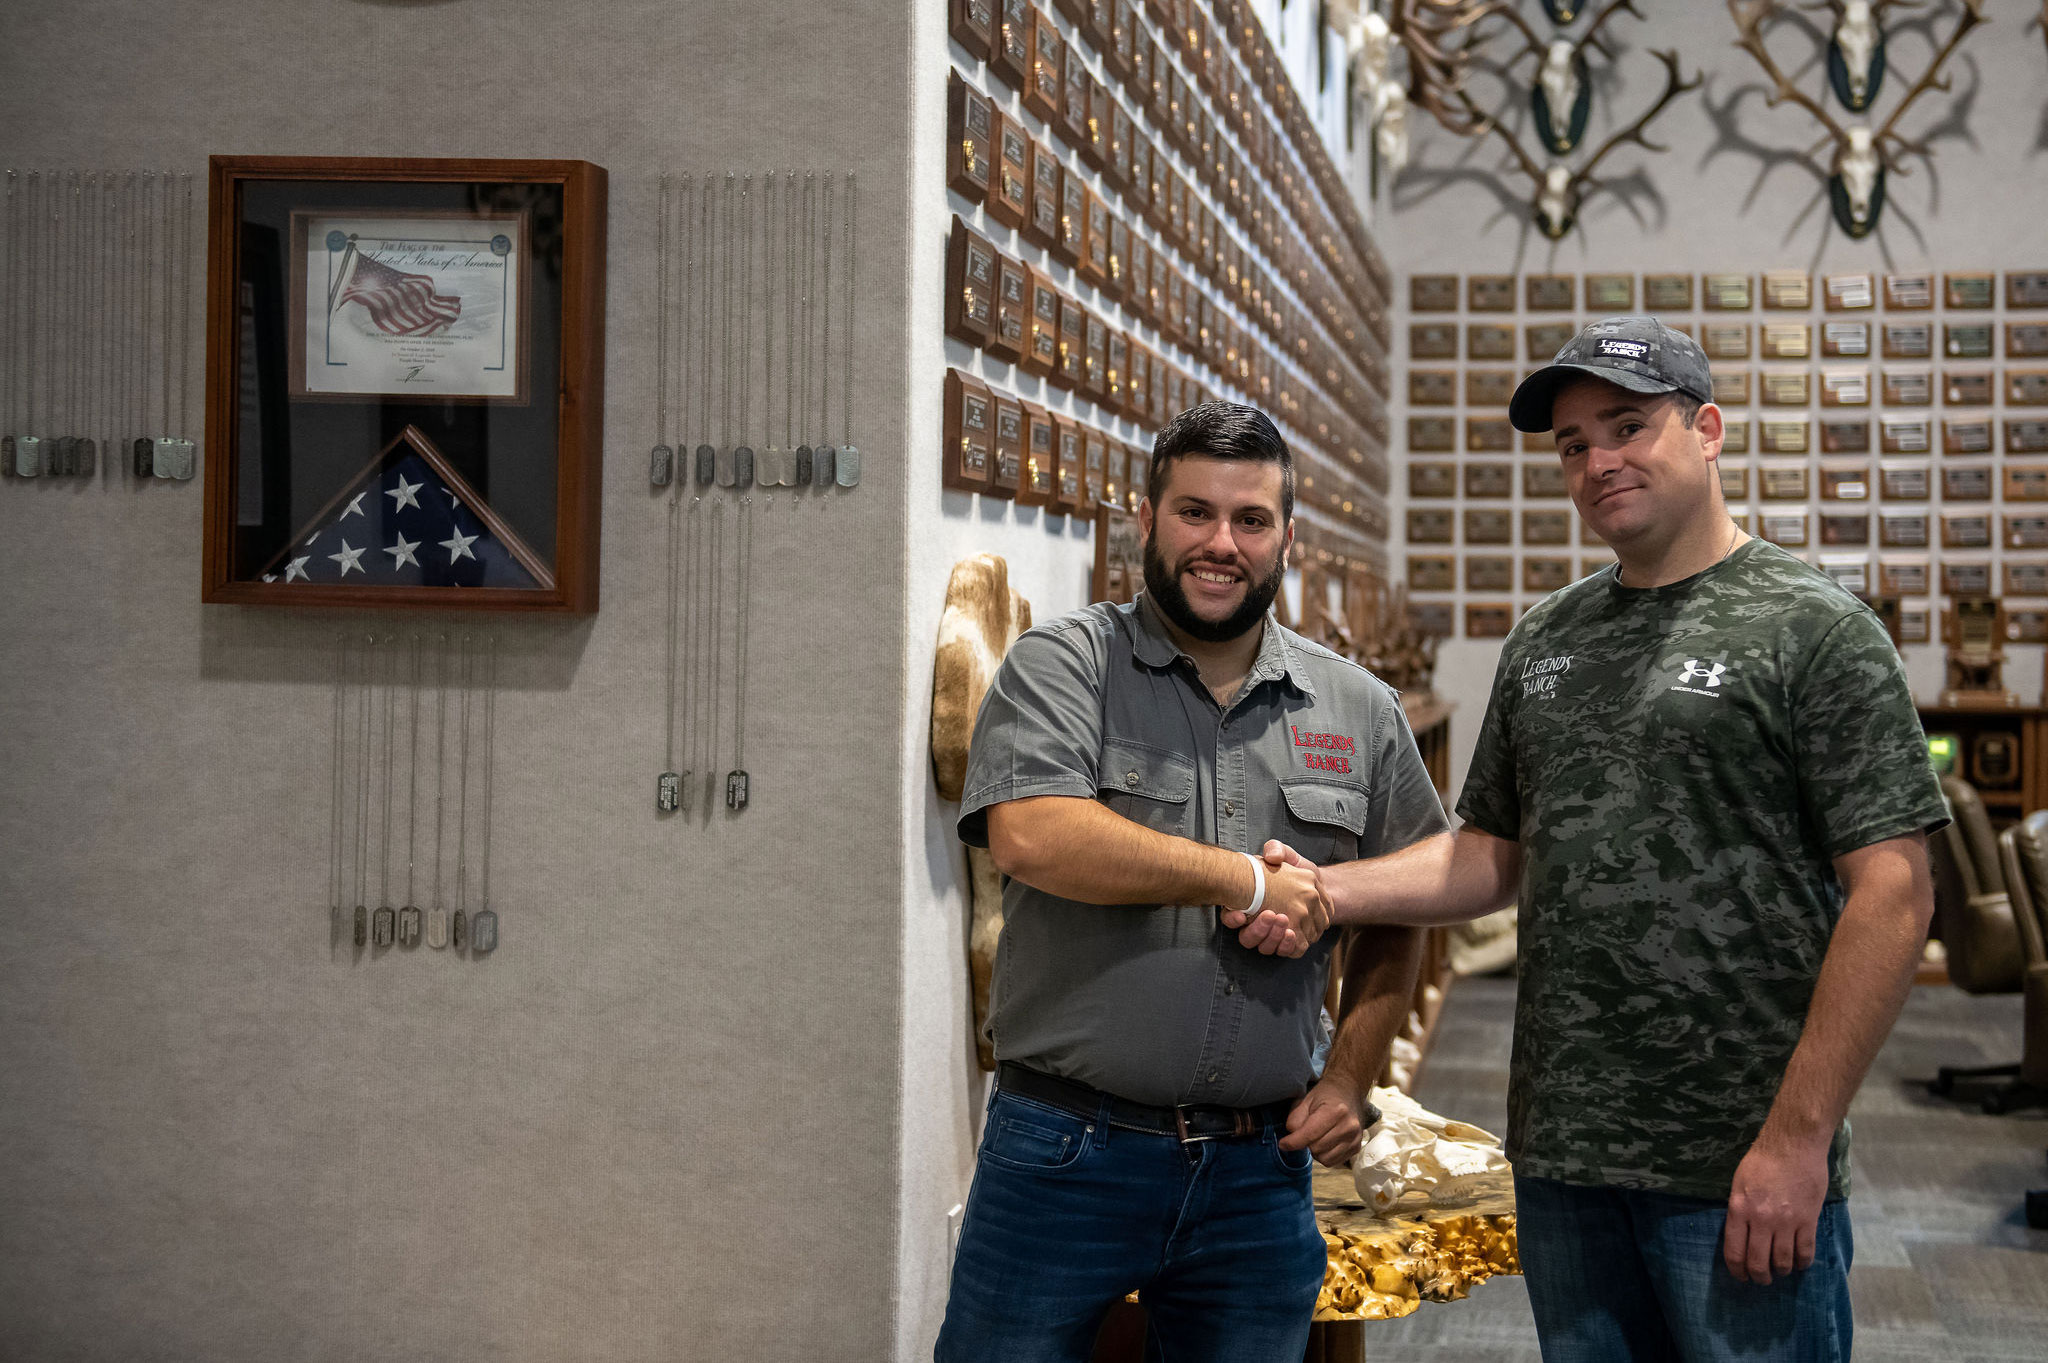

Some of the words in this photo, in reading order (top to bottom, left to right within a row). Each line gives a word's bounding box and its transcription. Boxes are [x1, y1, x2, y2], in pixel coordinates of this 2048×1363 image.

[453, 250, 504, 267] America
[1598, 339, 1648, 354] LEGENDS
[1519, 655, 1575, 681] LEGENDS
[1522, 674, 1558, 699] RANCH
[1691, 688, 1720, 698] ARMOUR
[1290, 725, 1356, 756] LEGENDS
[1303, 752, 1350, 774] RANCH
